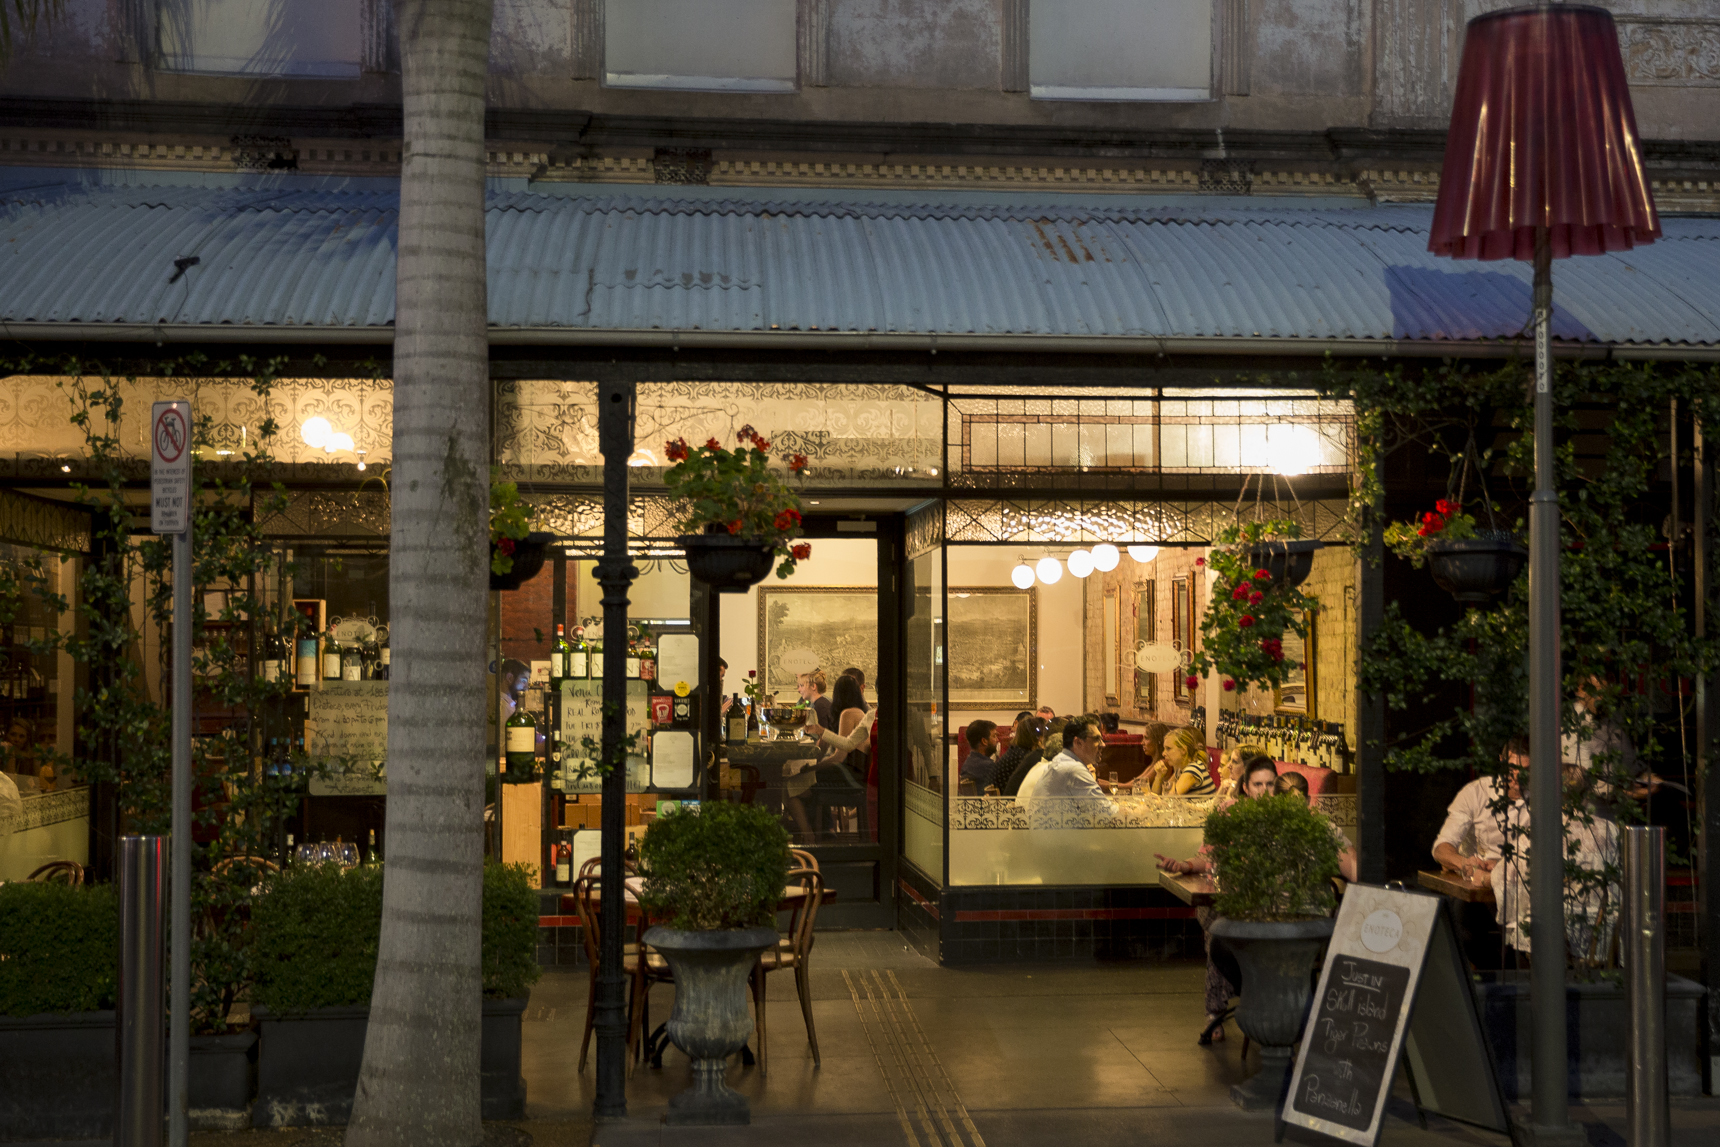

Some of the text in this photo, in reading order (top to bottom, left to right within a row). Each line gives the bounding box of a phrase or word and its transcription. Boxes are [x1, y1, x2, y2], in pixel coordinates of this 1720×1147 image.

[155, 497, 183, 508] MUST NOT
[1364, 923, 1400, 939] ENOTECA
[1320, 1017, 1388, 1054] Tiger Prawns
